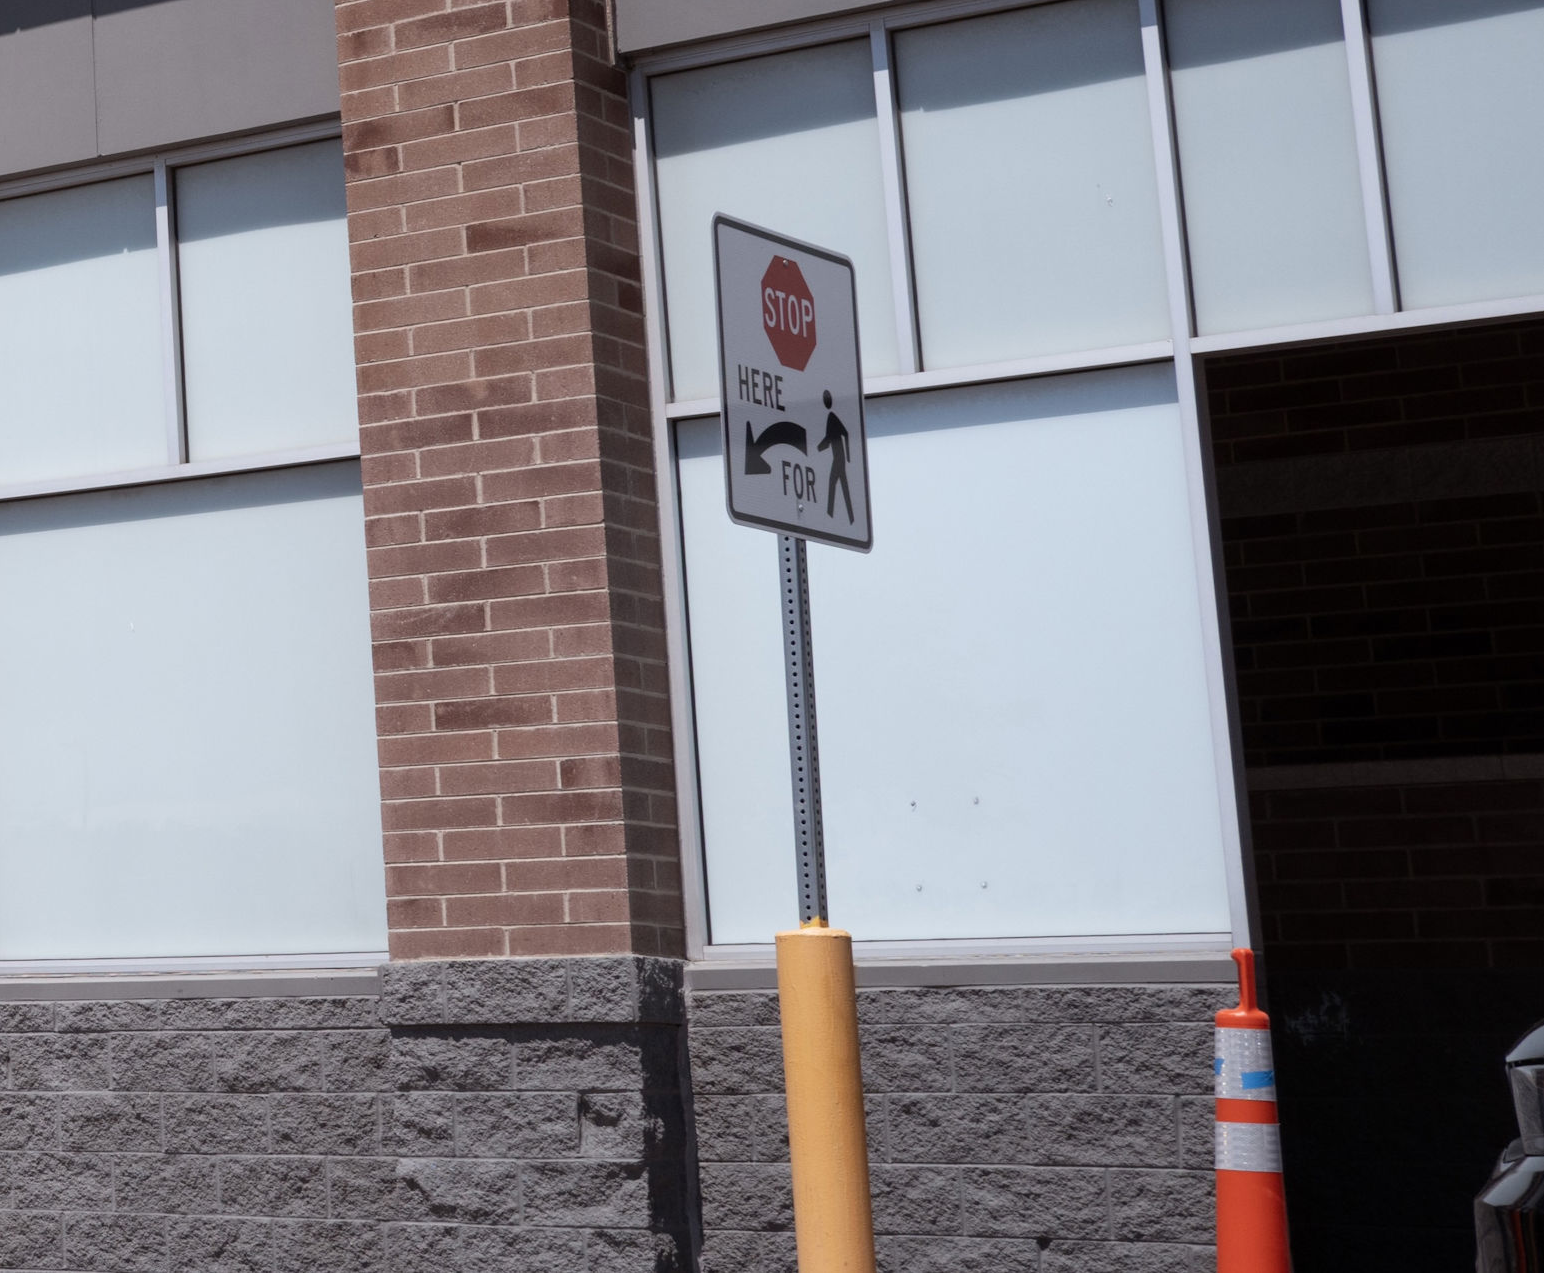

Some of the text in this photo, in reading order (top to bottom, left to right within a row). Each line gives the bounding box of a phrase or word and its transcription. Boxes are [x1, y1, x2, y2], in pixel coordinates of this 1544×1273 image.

[763, 286, 815, 339] STOP
[737, 363, 786, 412] HERE
[782, 460, 817, 504] FOR
